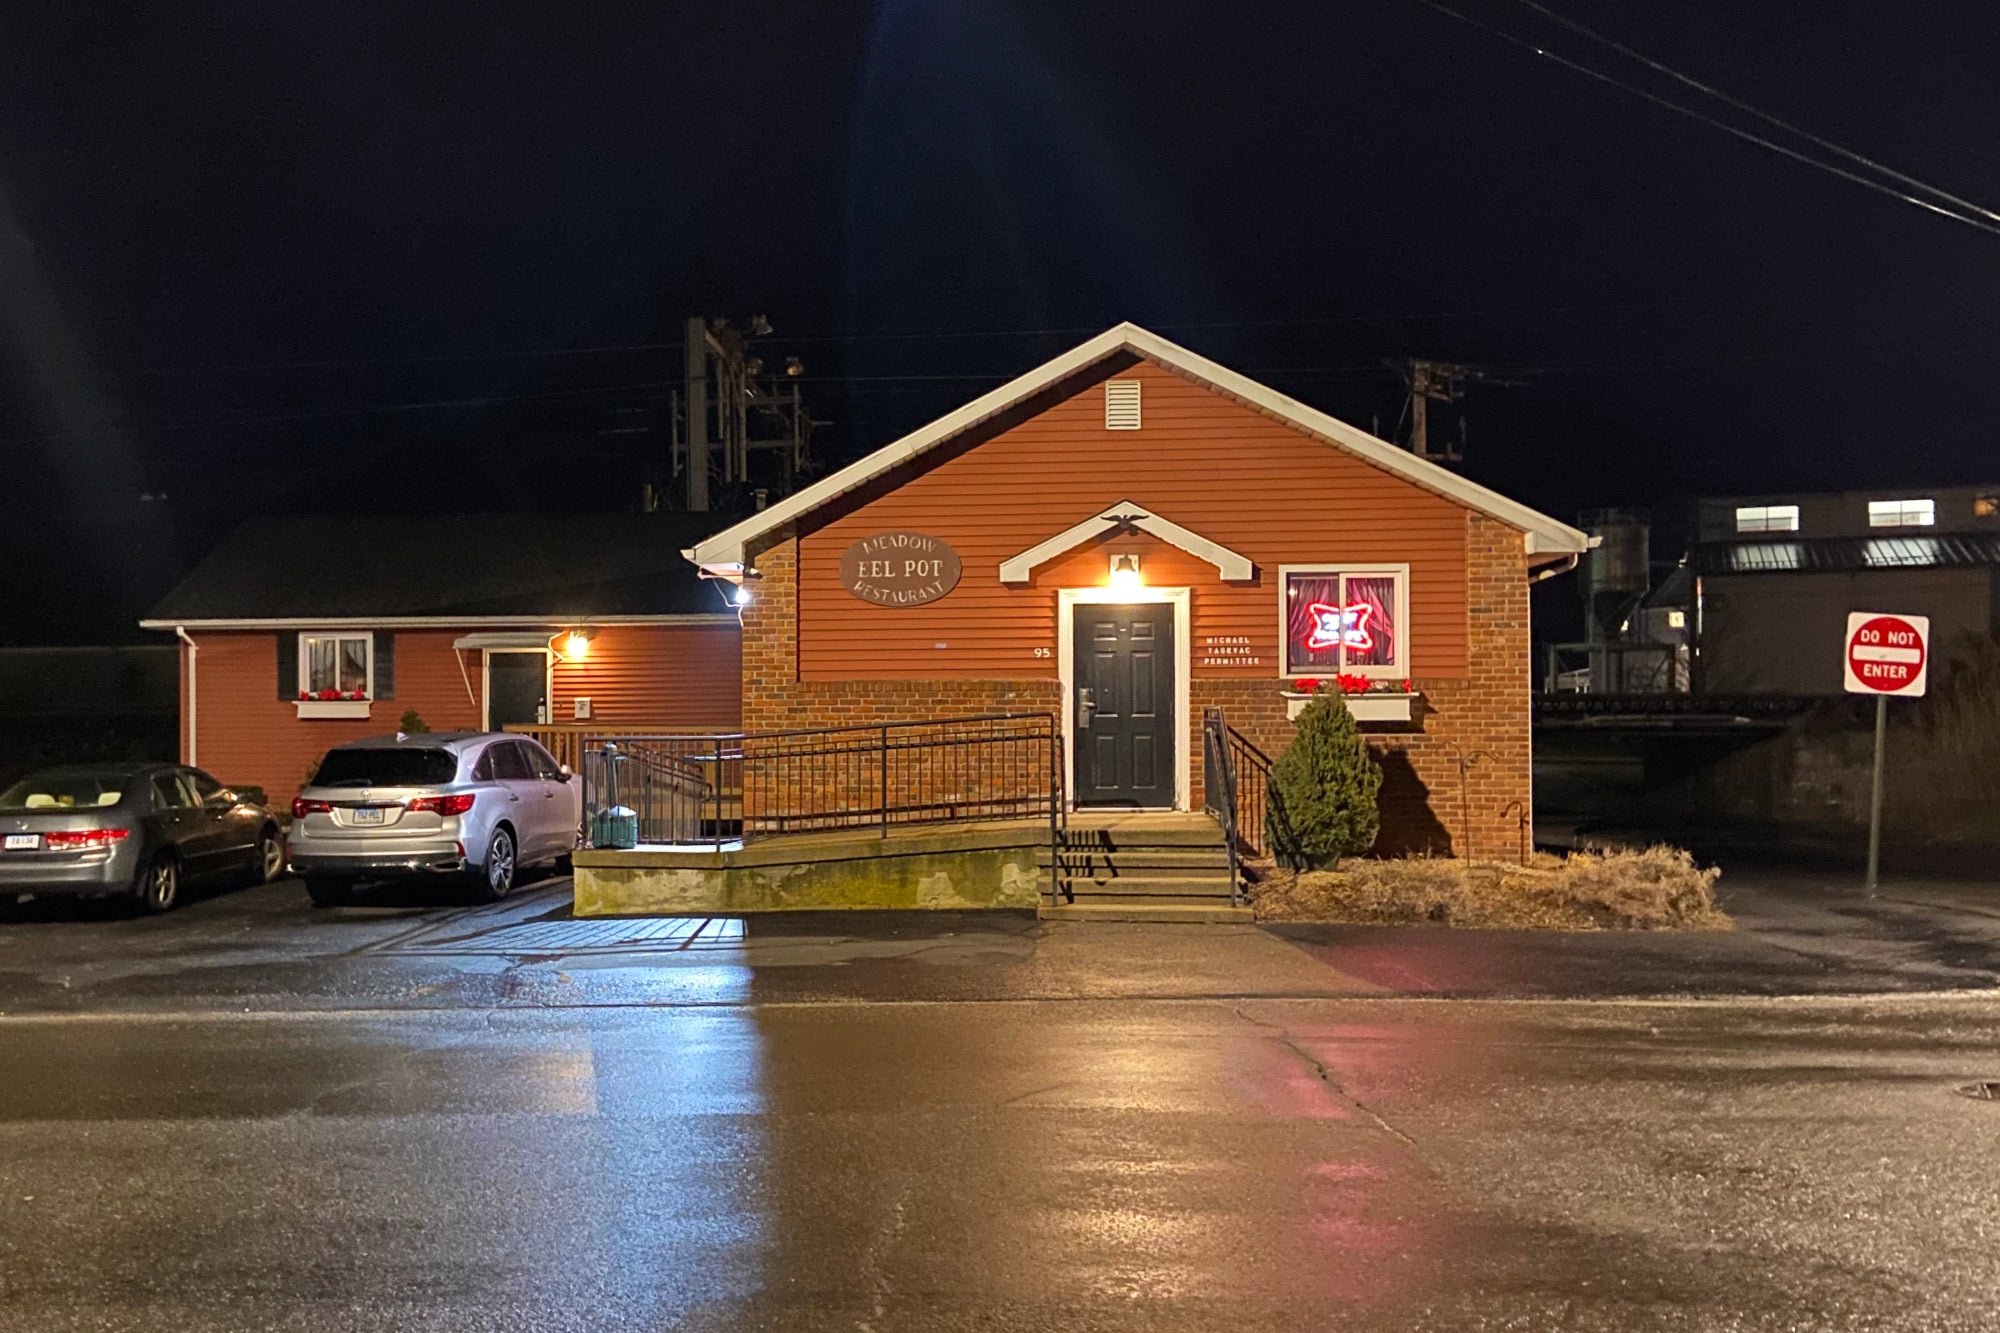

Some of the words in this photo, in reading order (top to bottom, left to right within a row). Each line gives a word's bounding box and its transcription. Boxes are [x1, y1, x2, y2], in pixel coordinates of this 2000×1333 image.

[862, 534, 936, 554] MEADOW
[858, 560, 896, 578] EEL
[904, 559, 943, 577] POT
[853, 579, 944, 603] RESTAURANT
[1206, 636, 1250, 644] MICHAEL
[1860, 629, 1880, 643] DO
[1887, 631, 1915, 645] NOT
[1034, 647, 1050, 658] 95
[1863, 663, 1908, 679] ENTER
